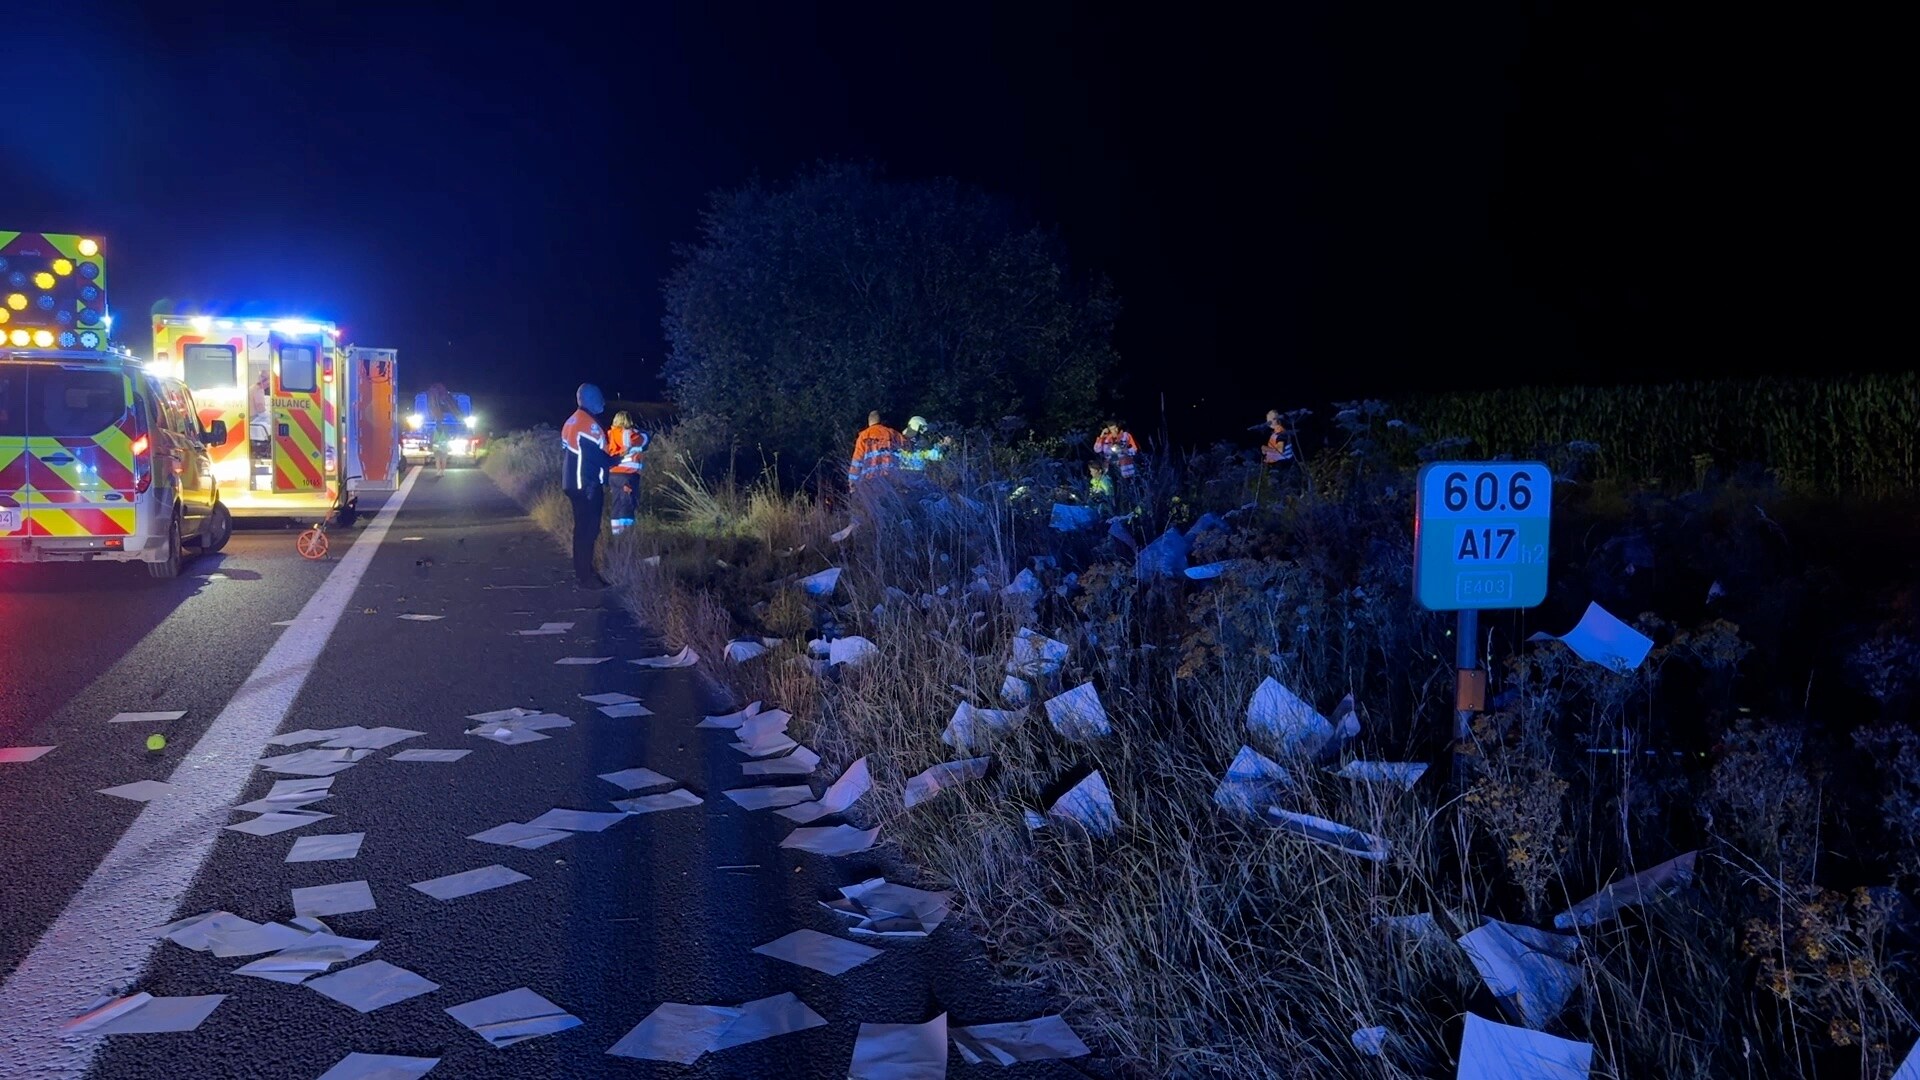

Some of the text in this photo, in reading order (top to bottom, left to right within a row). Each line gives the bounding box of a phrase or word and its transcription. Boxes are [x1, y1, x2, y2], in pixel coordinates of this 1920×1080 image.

[1444, 472, 1532, 512] 60.6
[1458, 529, 1545, 564] A17 h2
[1464, 580, 1505, 594] E403
